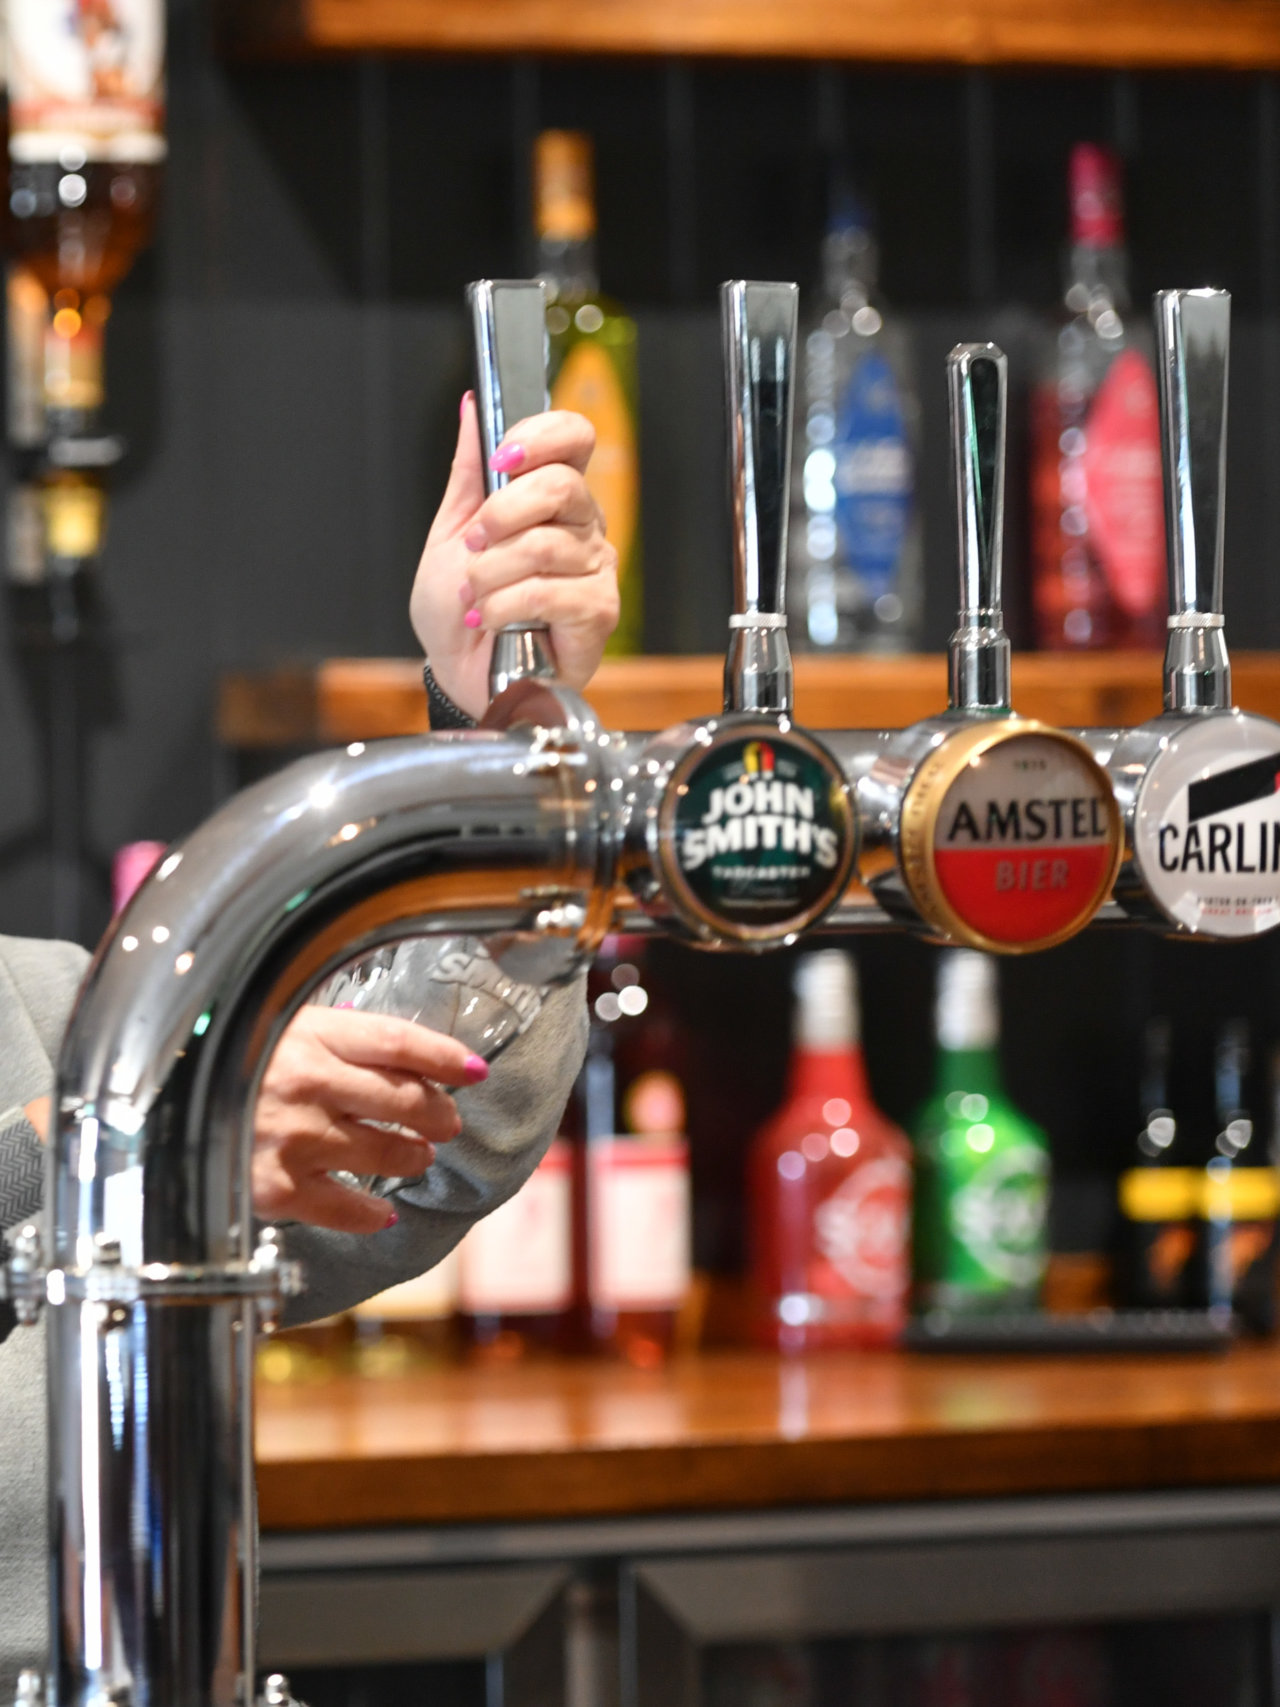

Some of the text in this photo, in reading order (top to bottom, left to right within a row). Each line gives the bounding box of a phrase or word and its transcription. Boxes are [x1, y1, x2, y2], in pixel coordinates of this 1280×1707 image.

[701, 780, 814, 825] JOHN
[947, 797, 1106, 842] AMSTEL
[683, 814, 838, 871] SMITH'S
[996, 859, 1069, 892] BIER
